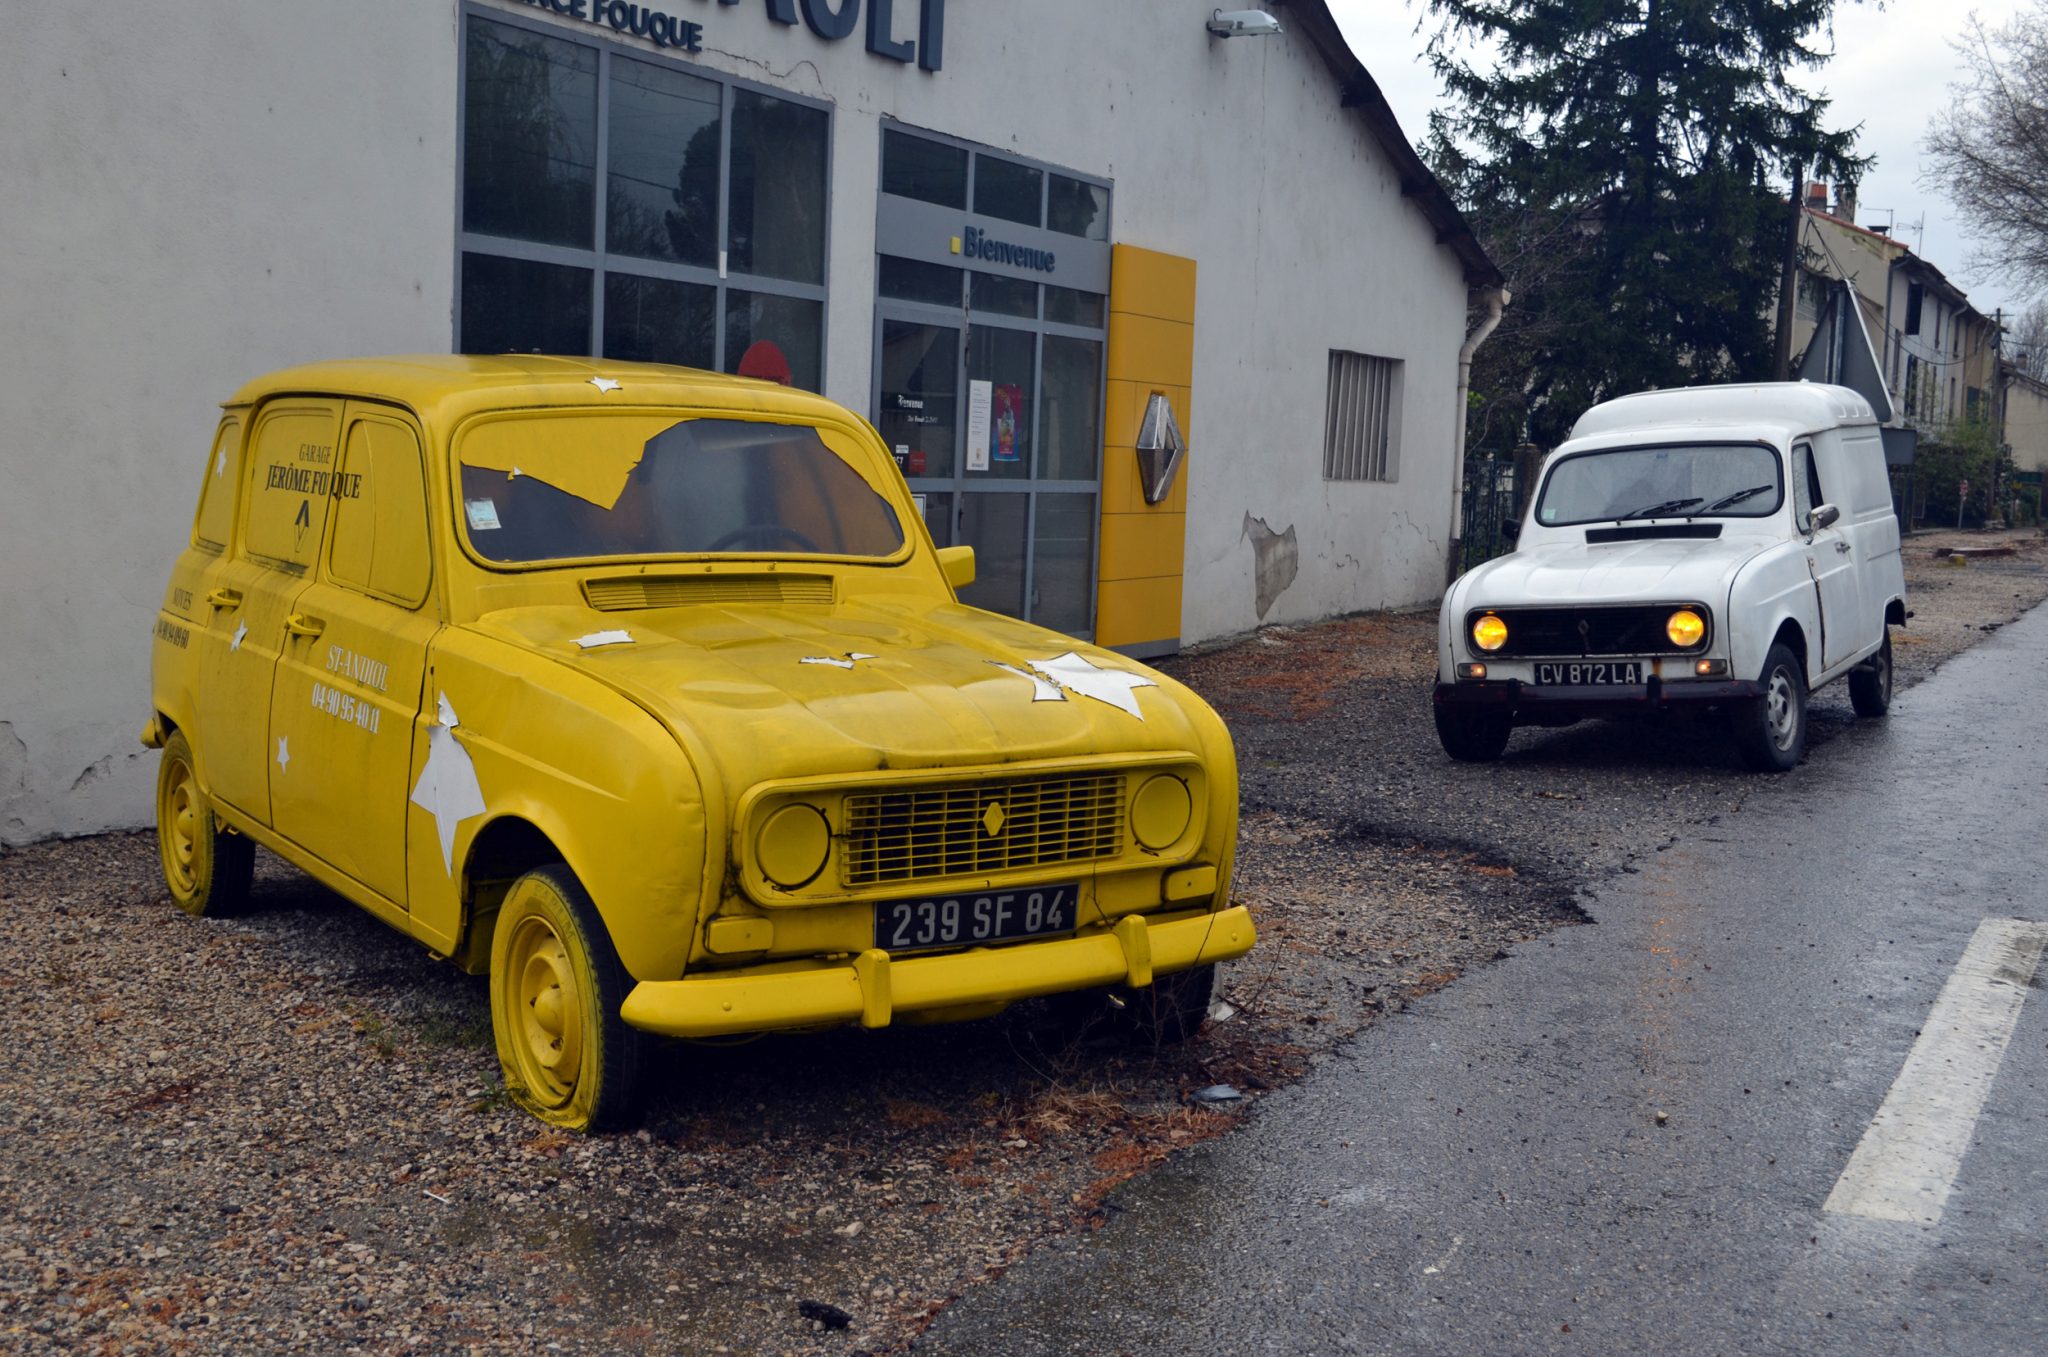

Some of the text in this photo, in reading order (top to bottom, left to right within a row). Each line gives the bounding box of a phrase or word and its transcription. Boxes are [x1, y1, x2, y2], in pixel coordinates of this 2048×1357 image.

[593, 0, 703, 53] FOUQUE
[964, 225, 1056, 273] Bienvenue
[299, 443, 332, 465] GARAGE
[265, 460, 362, 502] JÉRÔME FOUQUE
[327, 644, 389, 693] ST-ANDIOL
[1540, 664, 1636, 684] CV 872 LA
[311, 682, 380, 734] 04 90 95 40 11
[892, 890, 1065, 946] 239 SF 84
